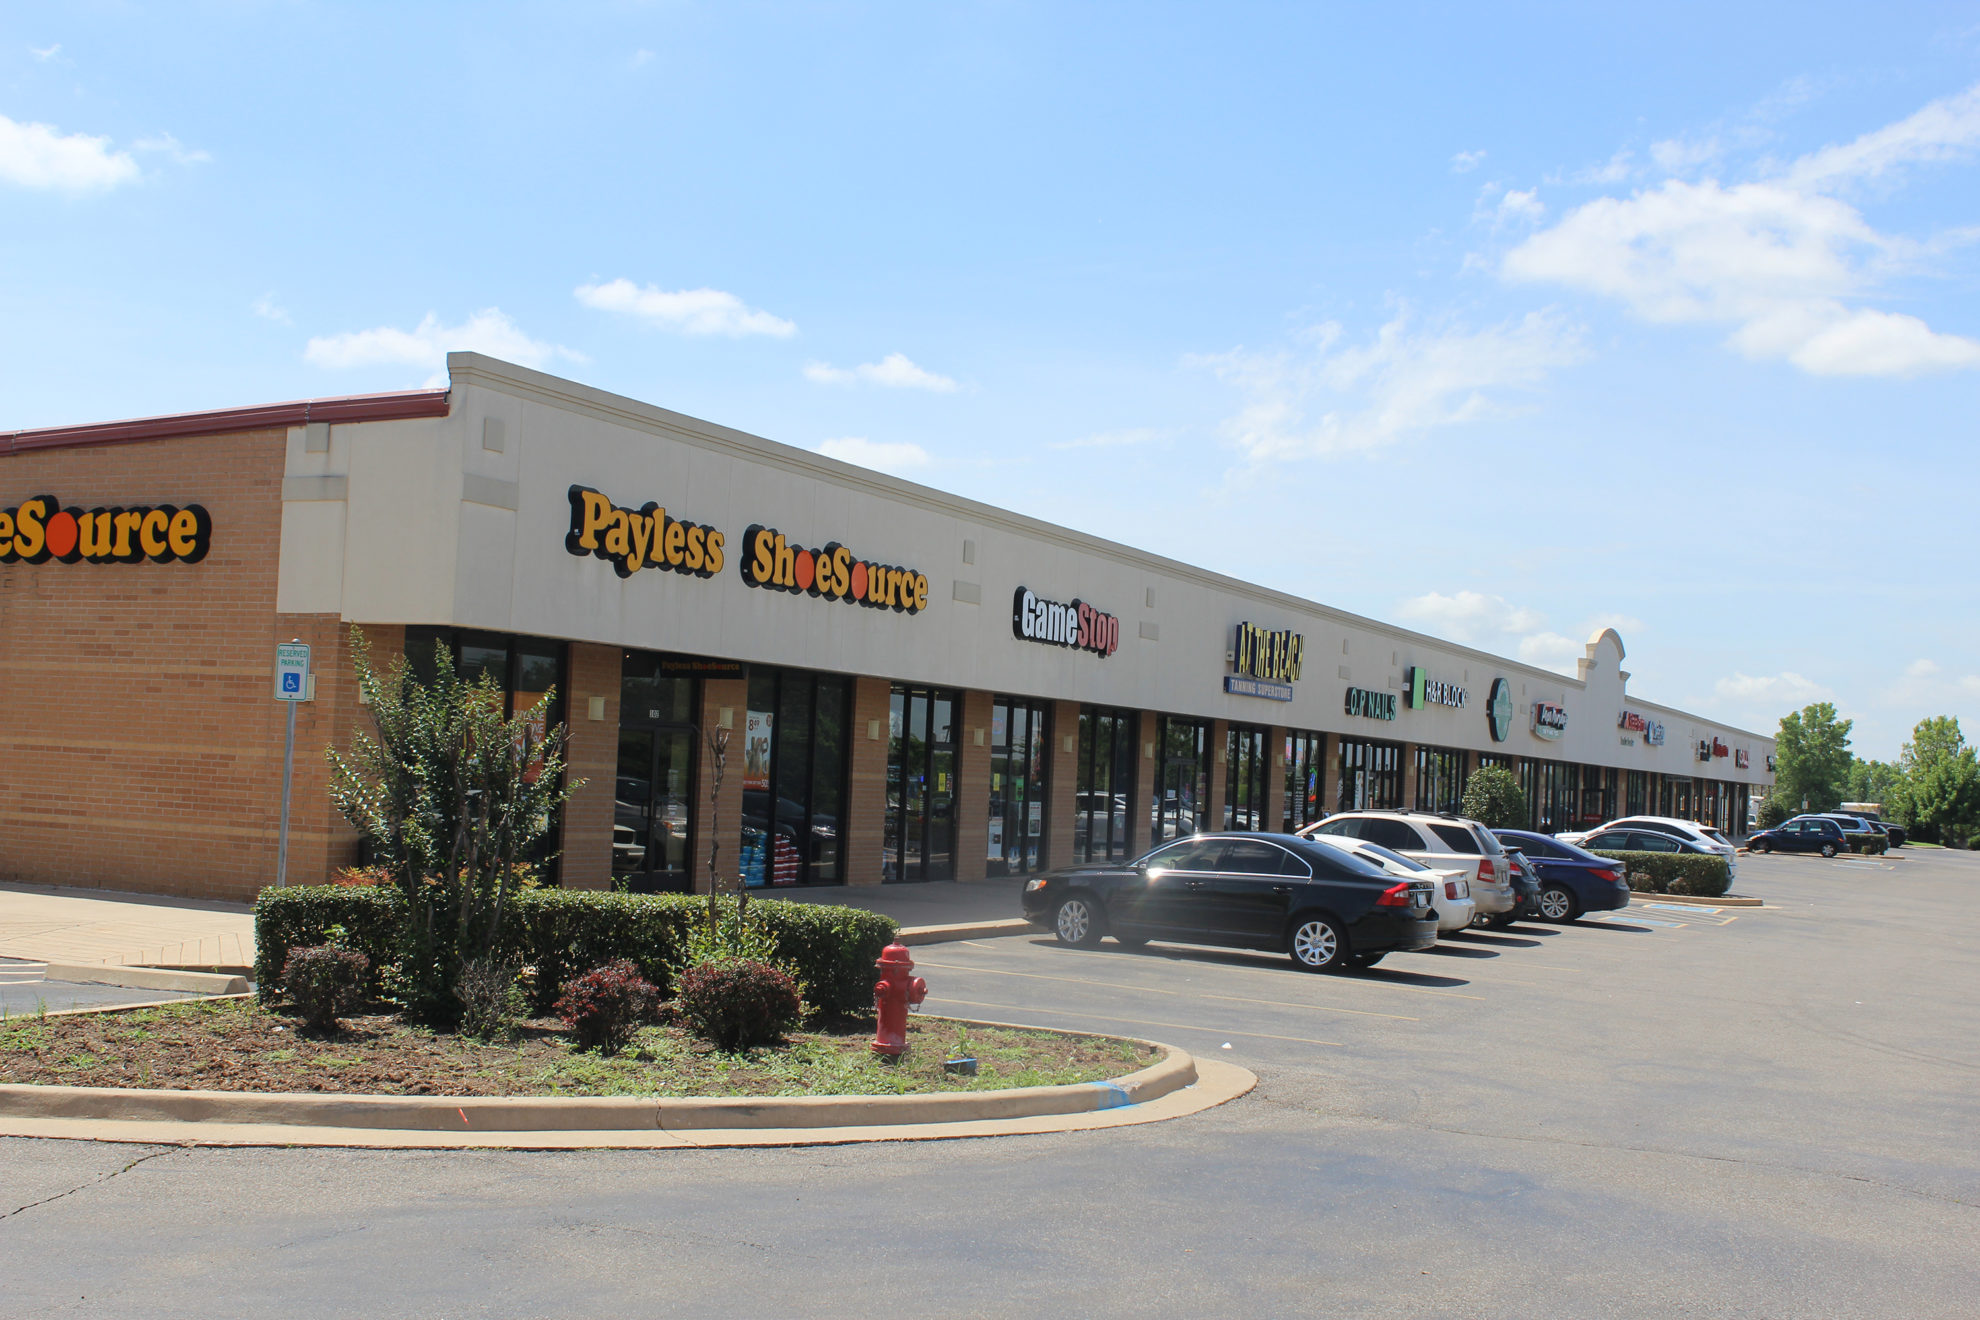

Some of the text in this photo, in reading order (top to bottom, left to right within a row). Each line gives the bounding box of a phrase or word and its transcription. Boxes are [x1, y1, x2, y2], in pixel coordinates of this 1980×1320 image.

[579, 491, 928, 611] Payless ShoeSource
[1021, 590, 1119, 656] GameStop
[279, 649, 307, 658] RESERVED
[281, 659, 304, 667] PARKING
[1239, 622, 1305, 683] AT THE BEACH
[1231, 679, 1292, 700] TANNING SUPERSTORE
[1426, 680, 1467, 709] H&R BLOCK
[1368, 691, 1397, 721] NAILS
